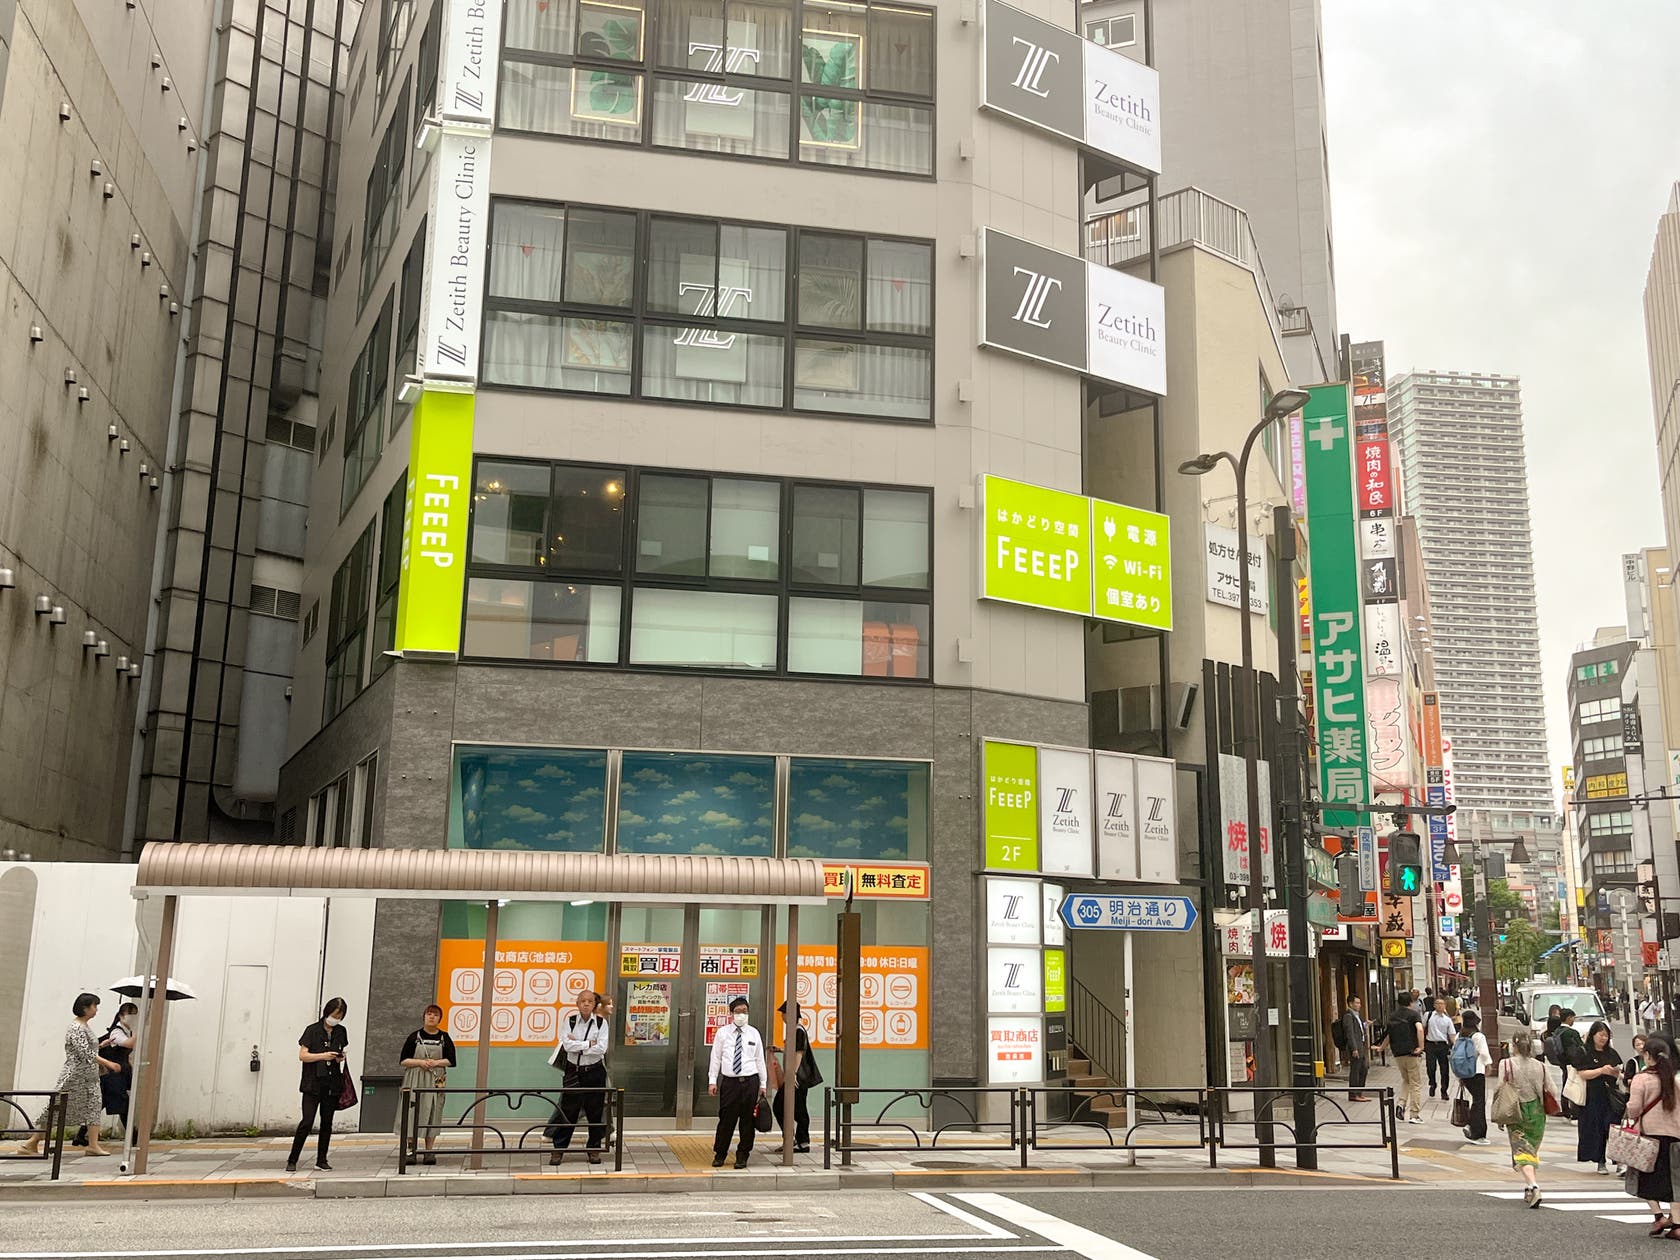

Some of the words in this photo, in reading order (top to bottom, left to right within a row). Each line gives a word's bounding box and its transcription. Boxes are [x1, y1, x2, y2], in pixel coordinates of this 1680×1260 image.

[463, 26, 483, 79] Zetith
[1094, 79, 1152, 123] Zetith
[1094, 104, 1124, 125] Beauty
[1126, 115, 1152, 136] Clinic
[455, 145, 476, 200] Clinic
[450, 206, 477, 268] Beauty
[446, 275, 467, 332] Zetith
[1097, 303, 1157, 342] Zetith
[1097, 329, 1129, 351] Beauty
[1130, 338, 1157, 357] Clinic
[420, 473, 459, 568] FEEEP
[997, 508, 1079, 538] はかどり空間
[1369, 510, 1383, 518] 6F
[1127, 525, 1157, 546] 電源
[997, 535, 1079, 582] FEEEP
[1124, 559, 1162, 581] Wi-Fi
[1106, 587, 1161, 613] 個室あり
[1318, 611, 1365, 804] アサヒ薬局
[989, 787, 1032, 808] FEEEP
[1052, 815, 1080, 828] Zetith
[1103, 819, 1130, 832] Zetith
[1144, 823, 1169, 835] Zetith
[1002, 845, 1021, 861] 2F
[861, 873, 921, 889] 無料査定
[1080, 905, 1100, 919] 305
[1109, 900, 1177, 917] 明治通り
[1111, 917, 1153, 926] Meiji-dori
[1156, 918, 1174, 926] Ave.
[482, 951, 573, 964] 取商店(池袋店)
[640, 957, 680, 973] 買取
[700, 956, 740, 973] 商店
[992, 1029, 1038, 1042] 買取商店
